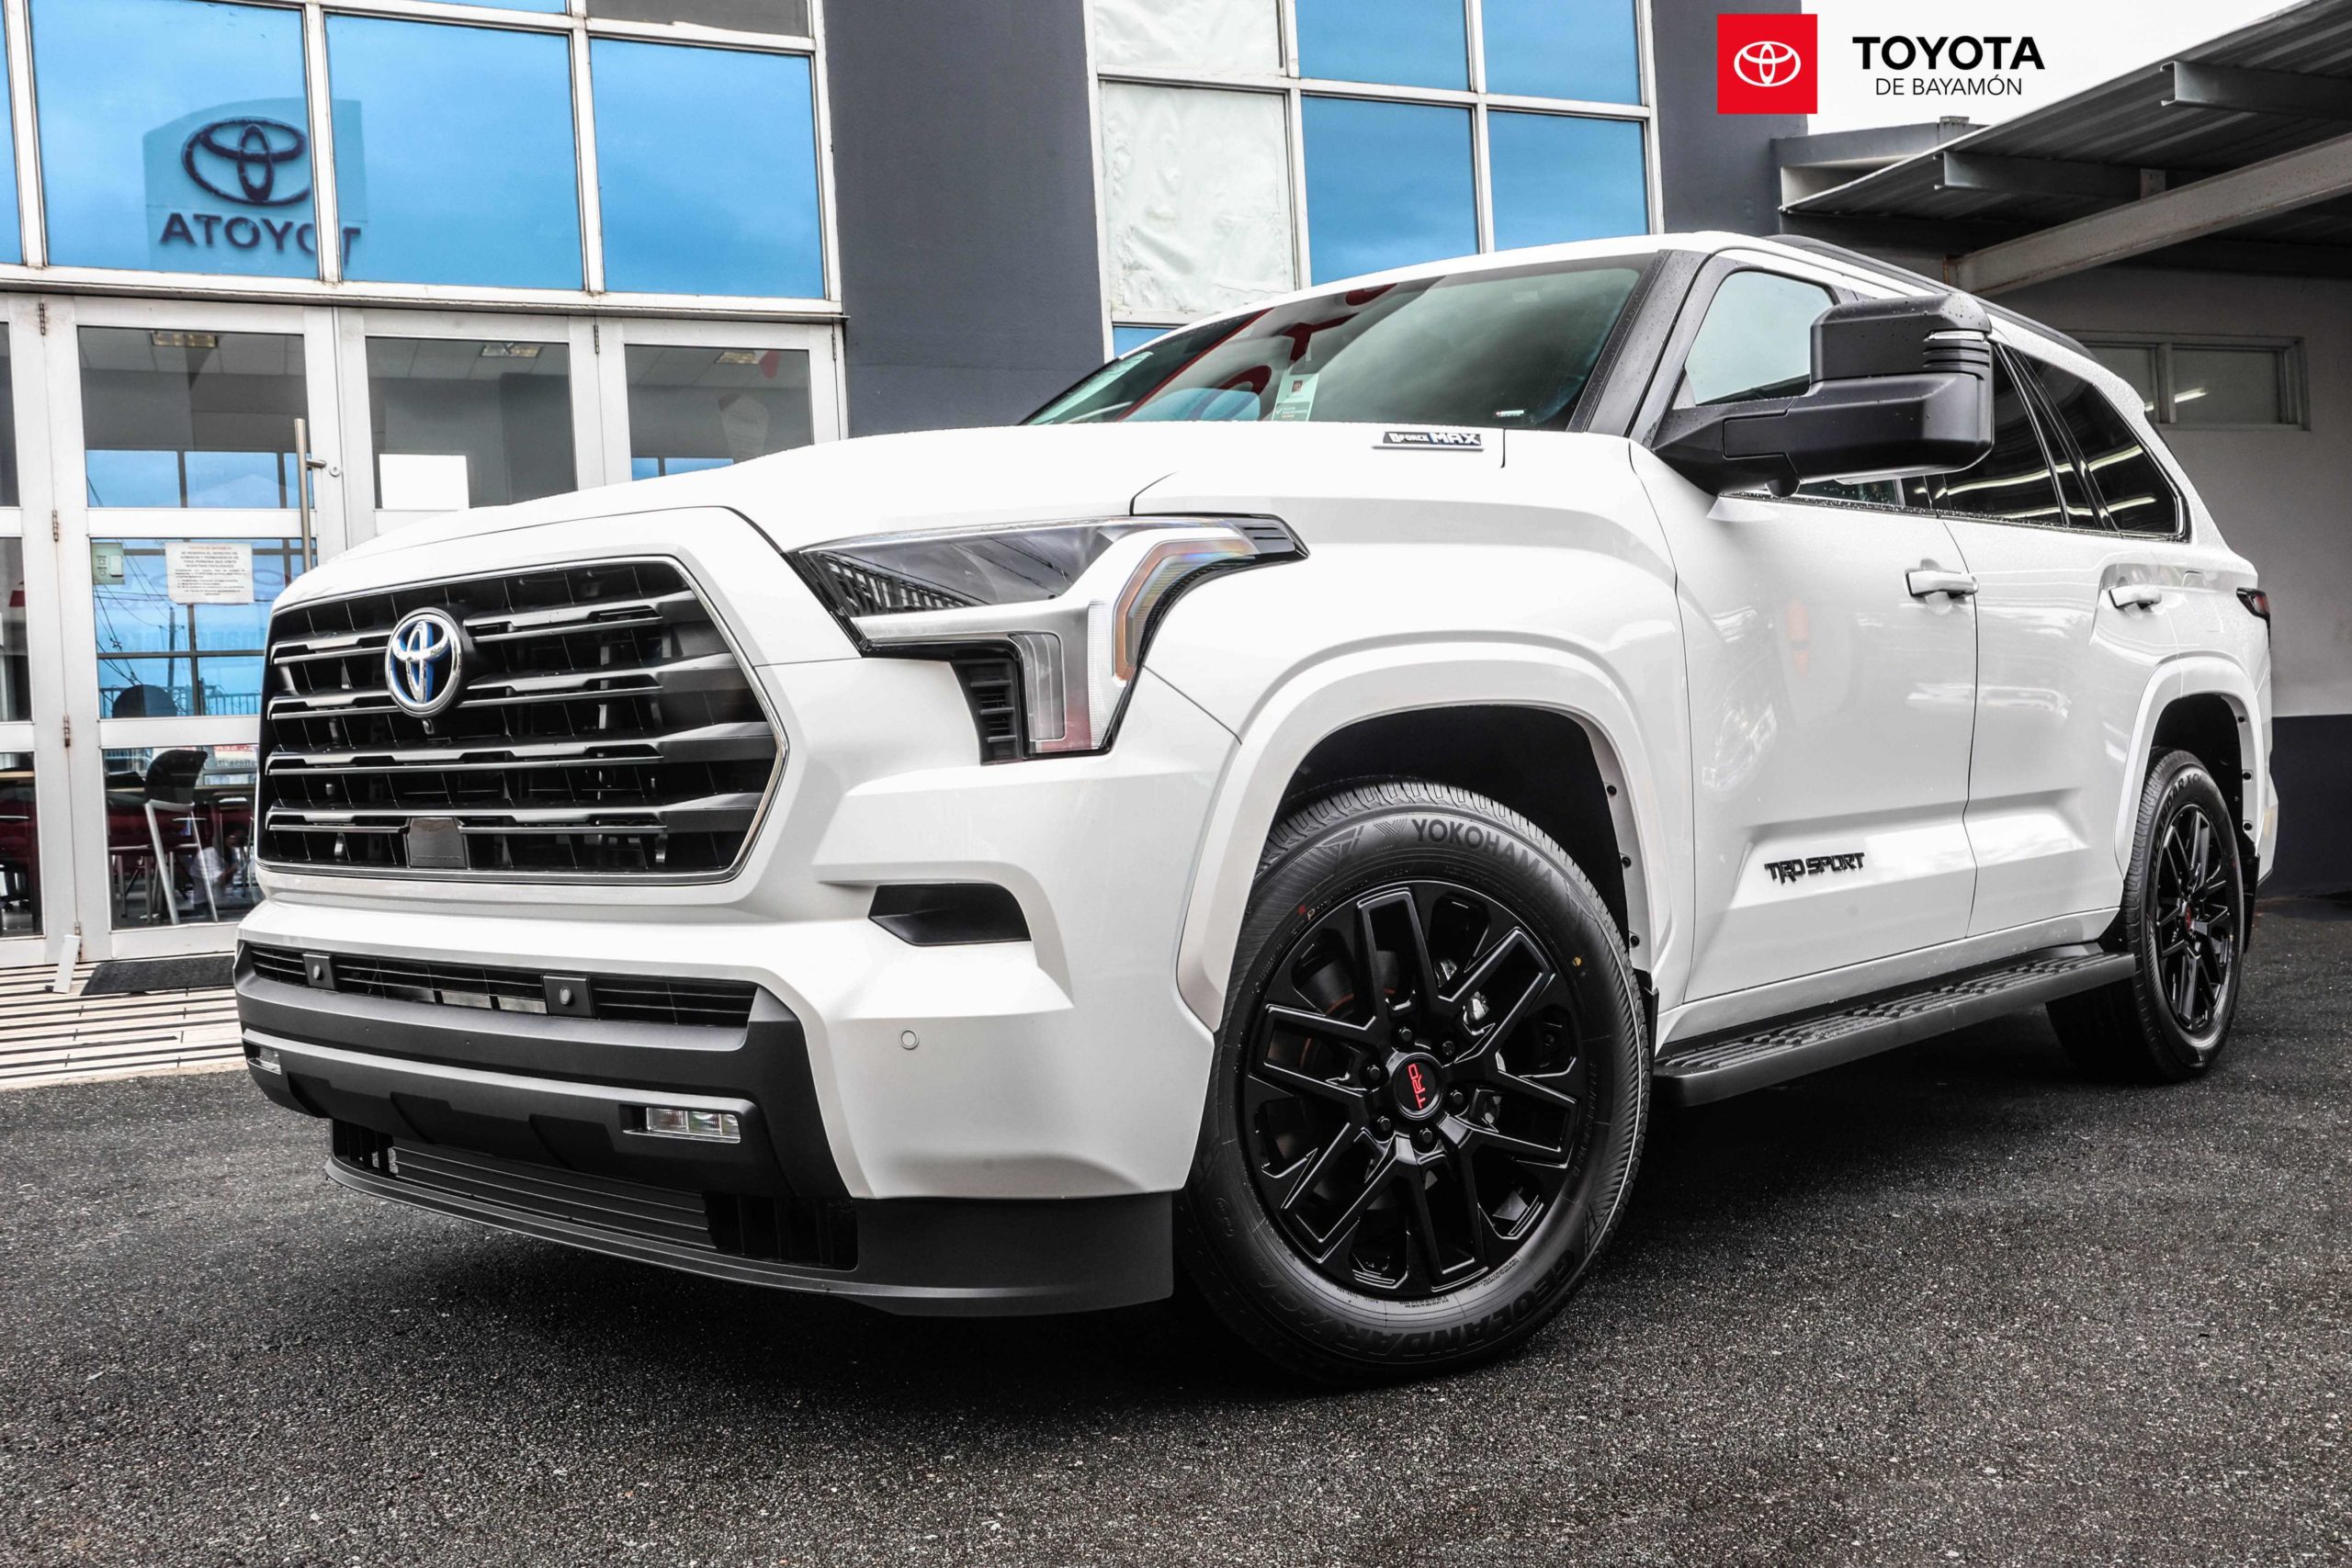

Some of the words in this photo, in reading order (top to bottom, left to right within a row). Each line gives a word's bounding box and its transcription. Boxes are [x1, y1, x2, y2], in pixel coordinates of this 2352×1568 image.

[1430, 433, 1481, 446] MAX
[1411, 818, 1555, 886] YOKOHAMA
[1764, 859, 1806, 885] TRD
[1805, 852, 1864, 875] SPORT
[1408, 1063, 1426, 1110] TRD
